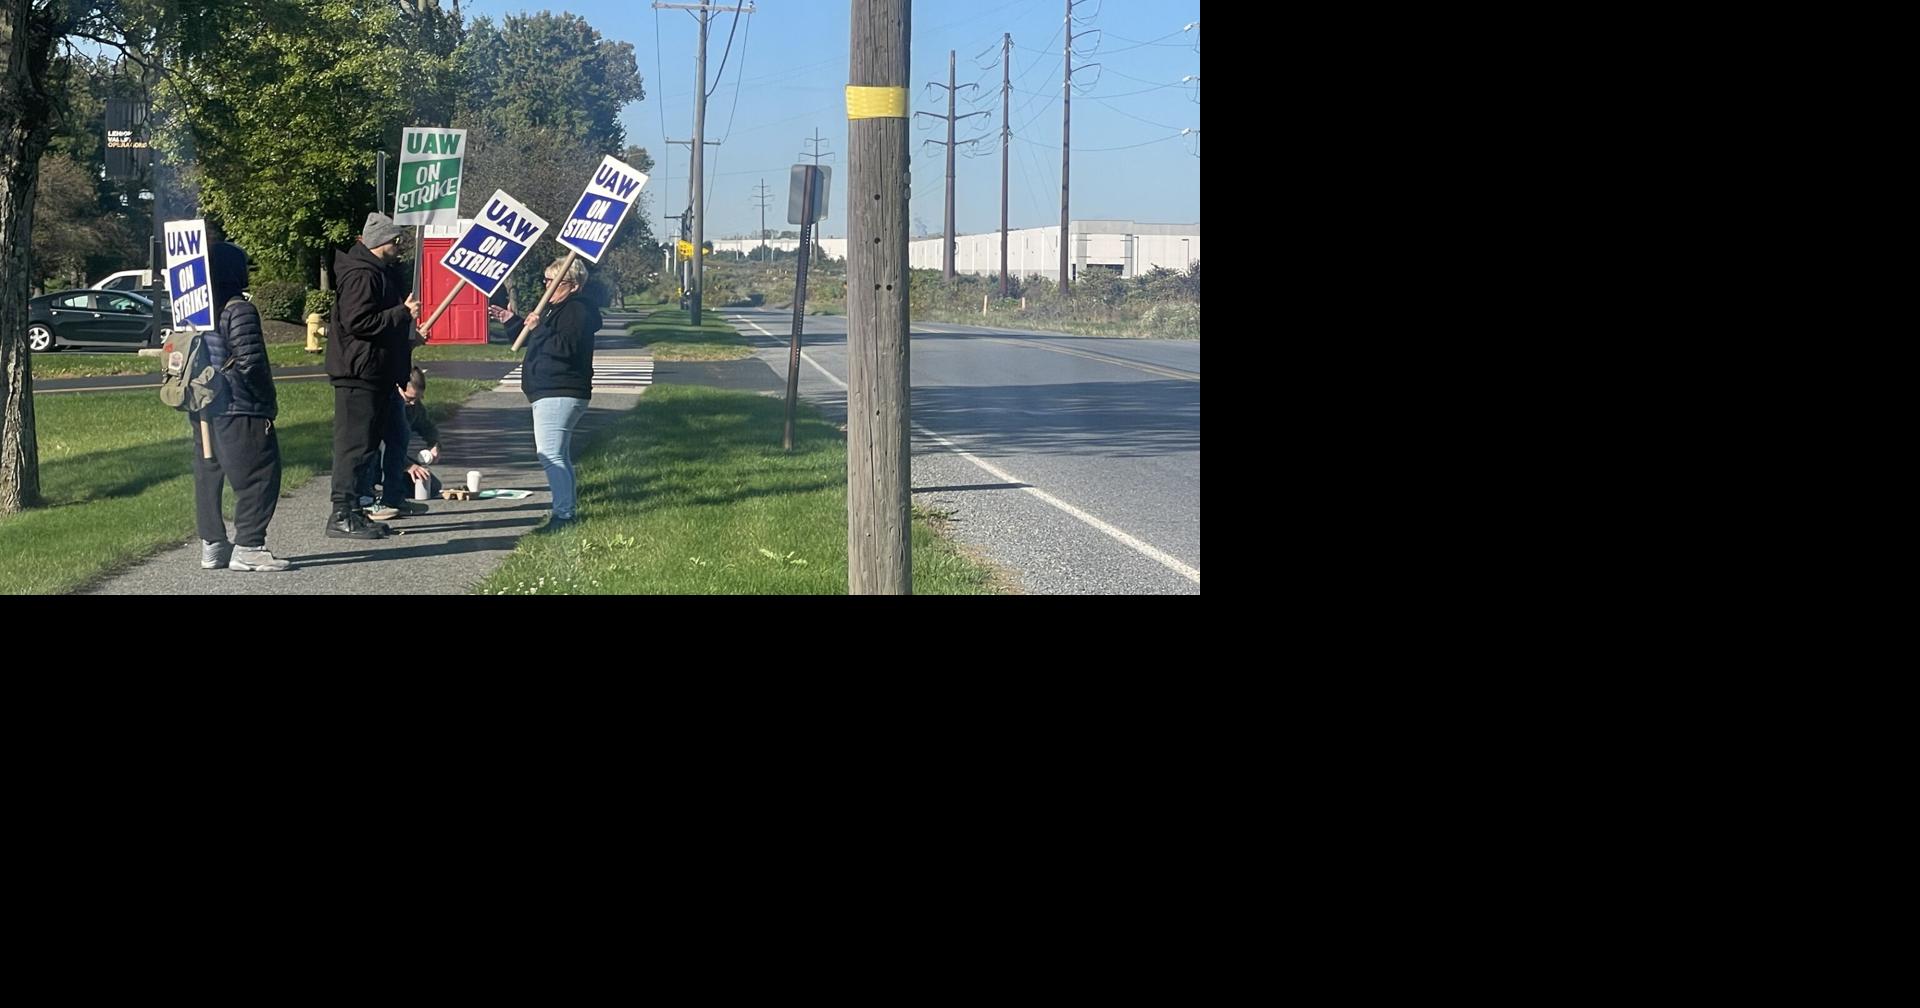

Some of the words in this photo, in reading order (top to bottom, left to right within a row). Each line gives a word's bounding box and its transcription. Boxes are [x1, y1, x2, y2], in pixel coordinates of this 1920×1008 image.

[407, 132, 461, 154] UAW
[416, 161, 441, 185] ON
[595, 163, 640, 200] UAW
[398, 176, 459, 212] STRIKE
[486, 199, 539, 242] UAW
[586, 199, 612, 220] ON
[167, 230, 201, 256] UAW
[563, 218, 614, 243] STRIKE
[478, 236, 508, 257] ON
[448, 247, 510, 280] STRIKE
[179, 264, 195, 293] ON
[173, 284, 209, 323] STRIKE
